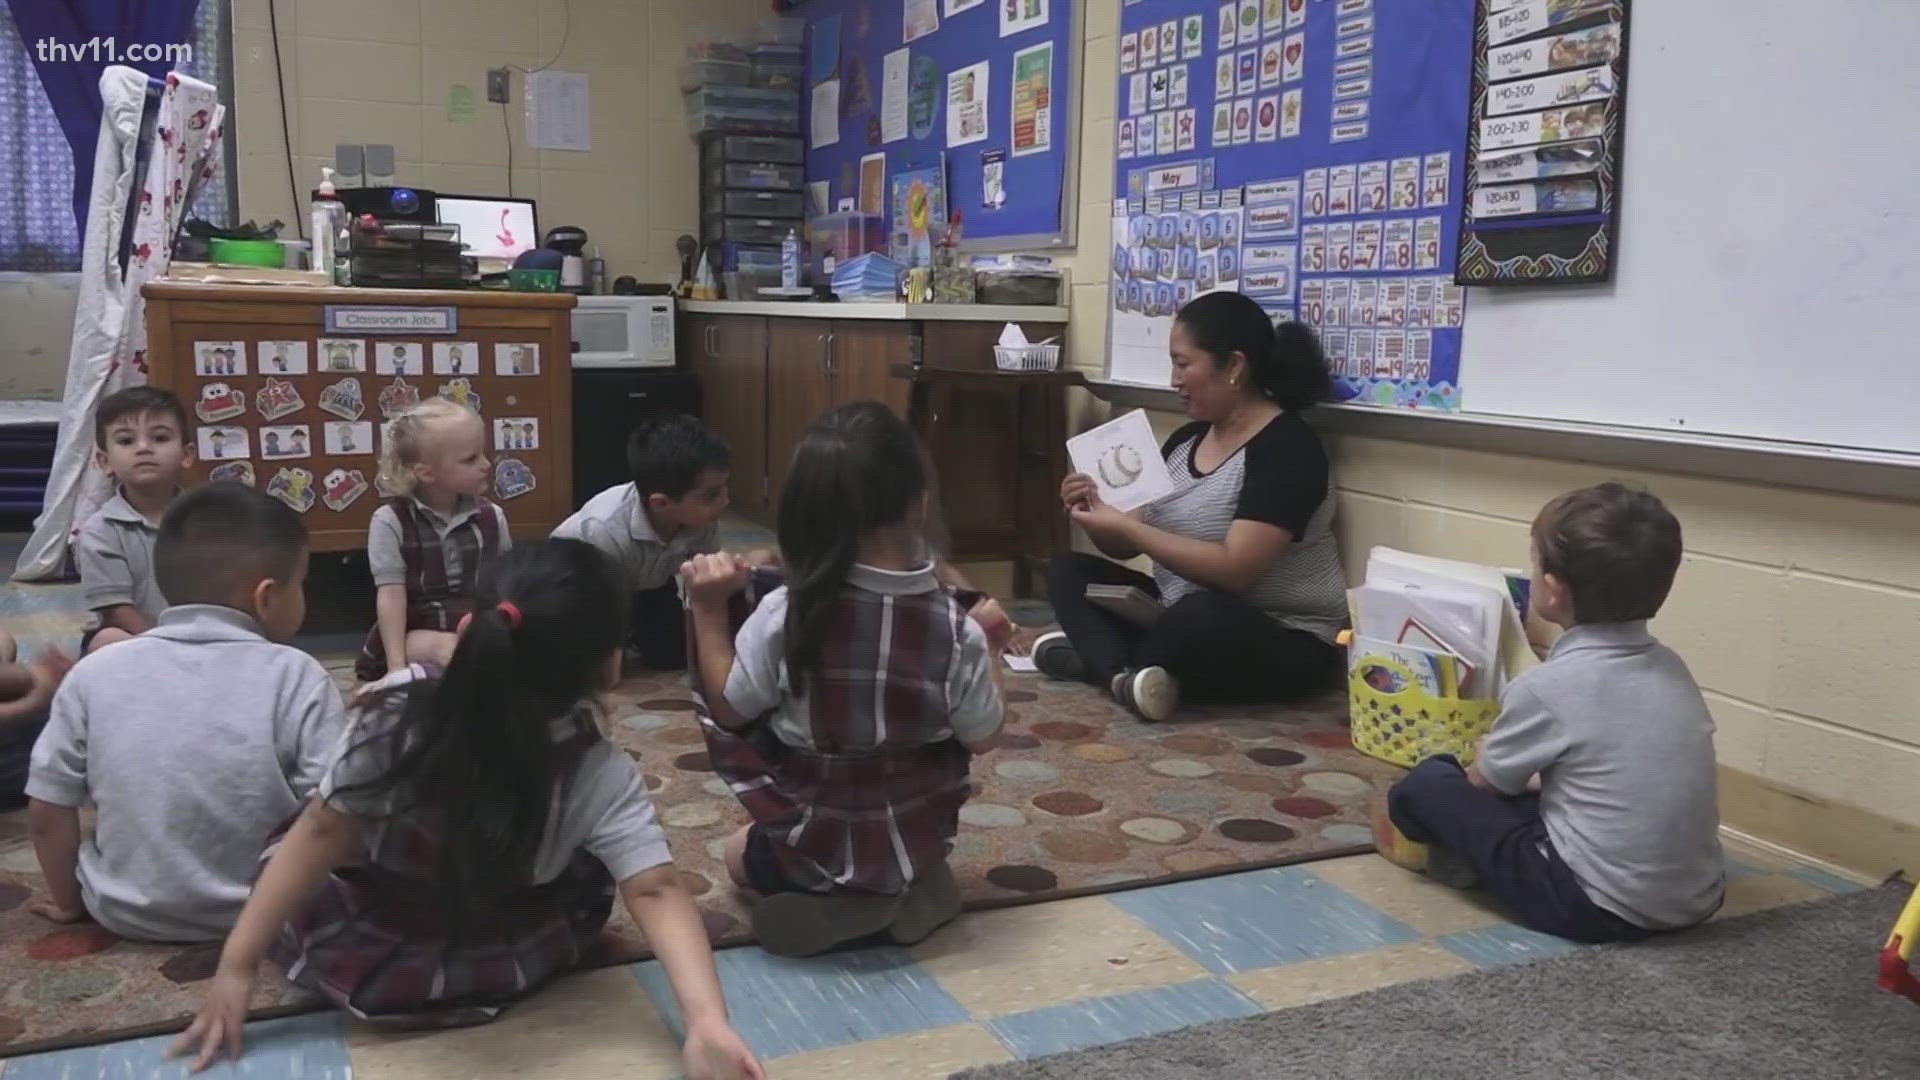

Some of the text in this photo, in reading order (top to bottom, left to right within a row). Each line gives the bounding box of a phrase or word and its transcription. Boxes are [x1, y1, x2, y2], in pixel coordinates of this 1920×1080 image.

[1162, 172, 1181, 186] May
[1347, 188, 1352, 212] 1
[1373, 186, 1385, 210] 2
[1404, 181, 1416, 207] 3
[1435, 178, 1446, 203] 4
[1312, 192, 1323, 215] 0
[1313, 245, 1323, 270] 5
[1339, 246, 1349, 270] 6
[1366, 244, 1377, 268] 7
[1399, 243, 1410, 267] 8
[1427, 241, 1437, 266] 9
[346, 314, 437, 325] Classroom Jobs
[1306, 302, 1322, 325] 10
[1338, 307, 1346, 326] 11
[1362, 307, 1373, 326] 12
[1391, 308, 1405, 326] 13
[1419, 308, 1431, 326] 14
[1447, 306, 1460, 325] 15
[1334, 357, 1345, 374] 17
[1360, 359, 1371, 376] 18
[1390, 360, 1403, 377] 19
[1414, 361, 1428, 379] 20
